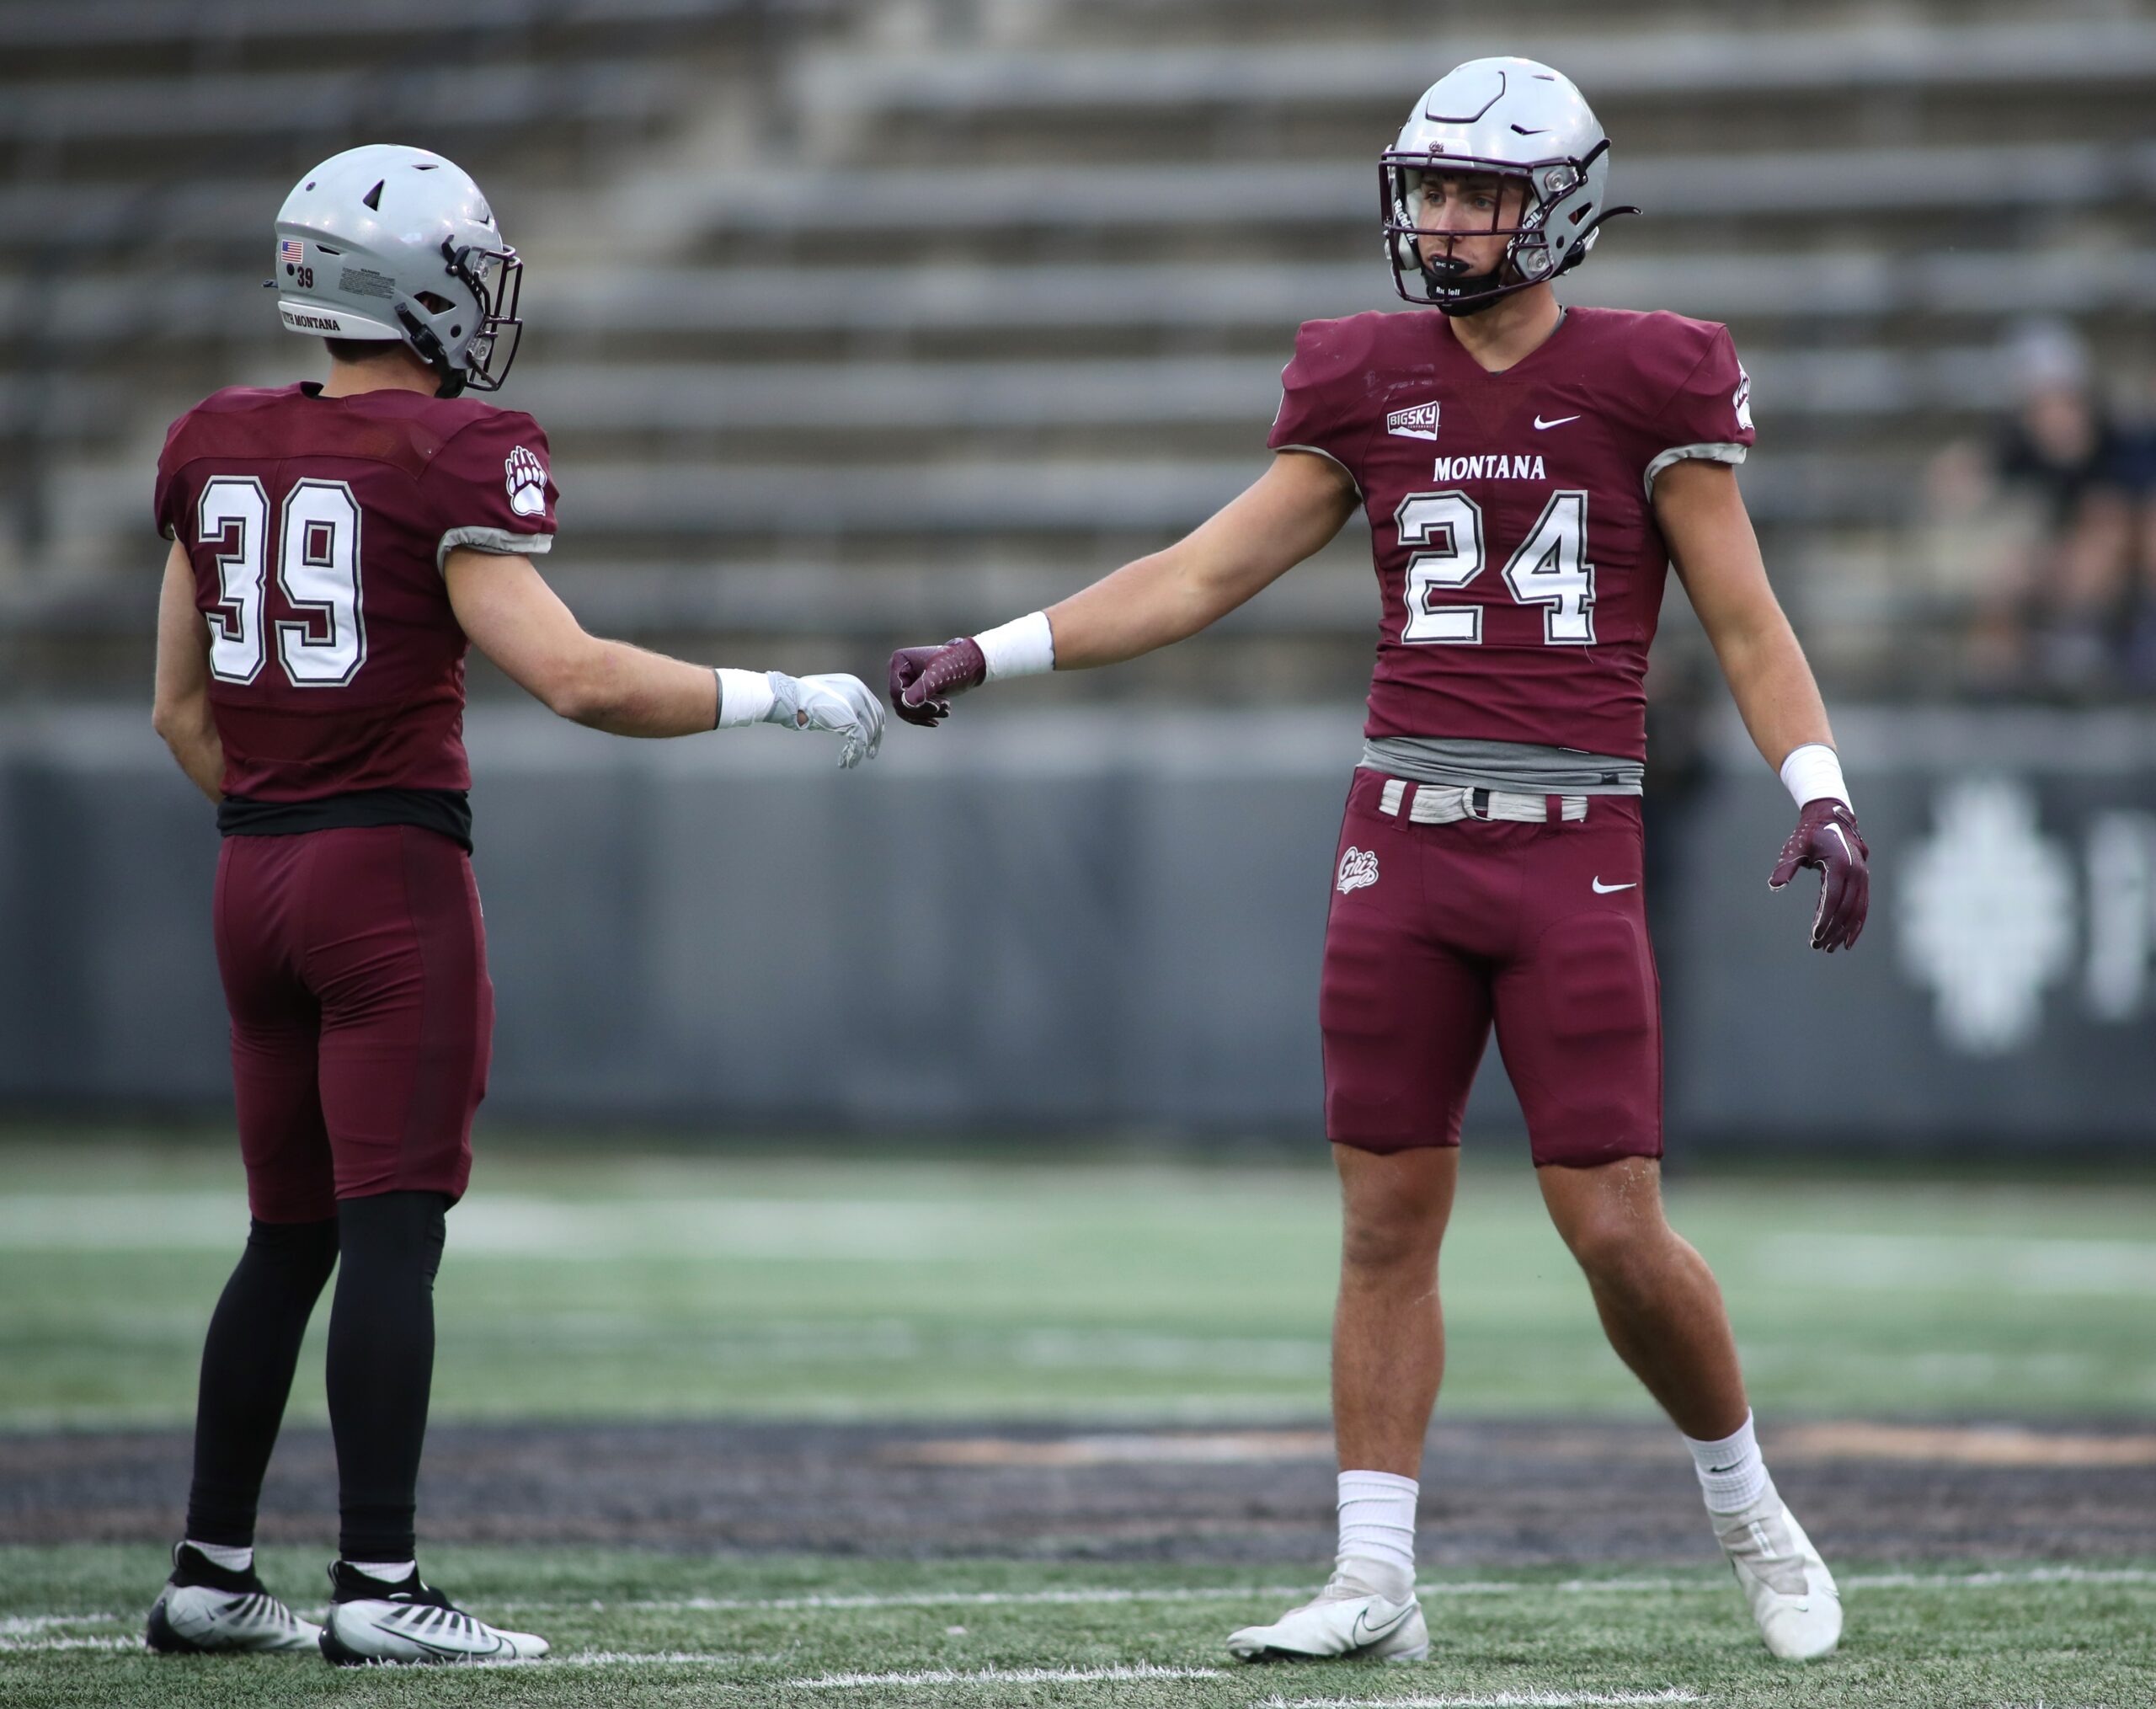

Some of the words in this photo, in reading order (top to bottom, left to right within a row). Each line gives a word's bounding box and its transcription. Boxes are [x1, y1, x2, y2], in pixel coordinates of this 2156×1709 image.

[1394, 198, 1417, 241] Riddll
[297, 265, 313, 289] 39
[294, 314, 341, 331] MONTANA
[1433, 455, 1546, 482] MONTANA
[198, 475, 367, 687] 39
[1393, 489, 1598, 645] 24
[1337, 846, 1379, 895] Griz
